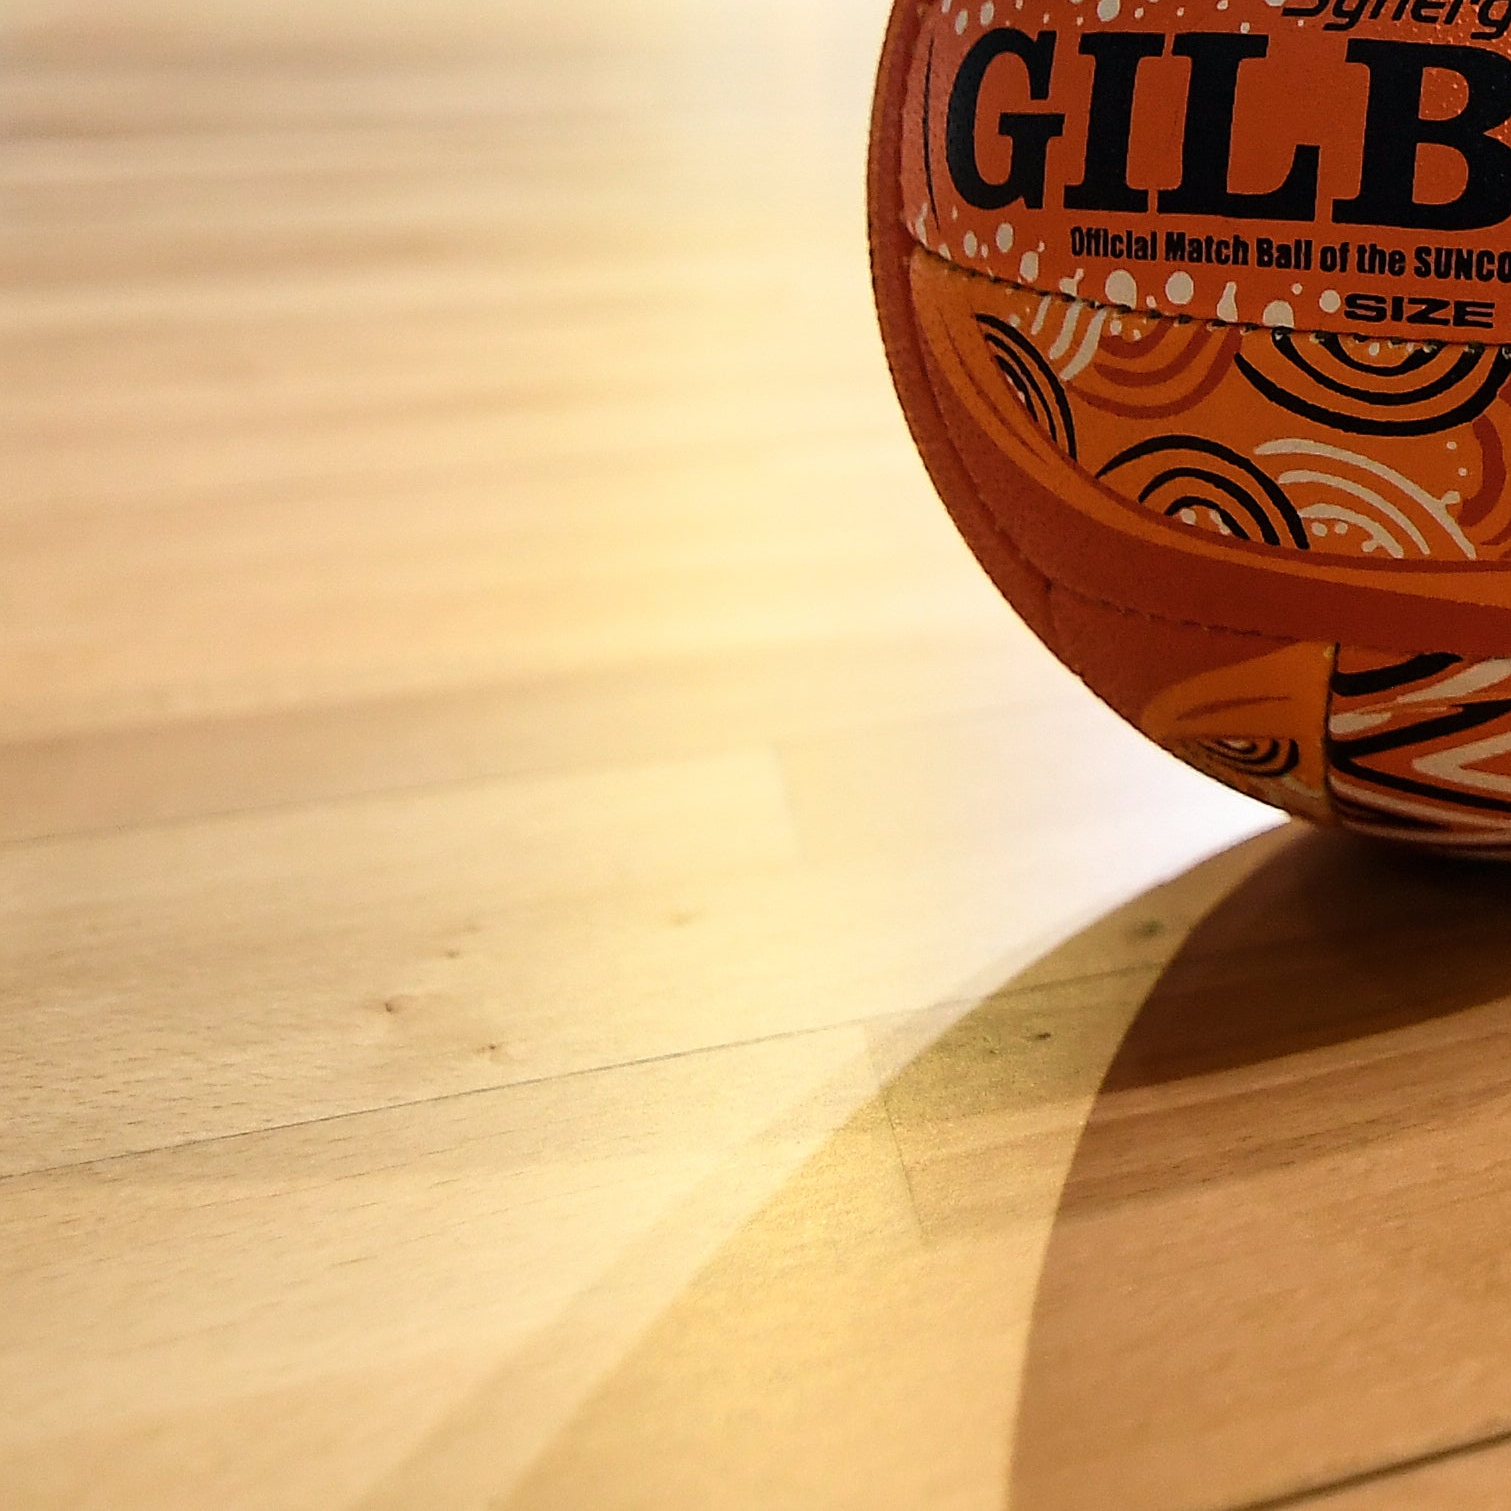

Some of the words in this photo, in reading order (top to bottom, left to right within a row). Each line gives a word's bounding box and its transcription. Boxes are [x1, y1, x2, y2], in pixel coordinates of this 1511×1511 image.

[1070, 226, 1157, 260] Official
[1164, 234, 1249, 266] Match
[1256, 238, 1313, 271] Ball
[1319, 242, 1350, 272] of
[1356, 244, 1406, 276] the
[1344, 293, 1496, 328] SIZE
